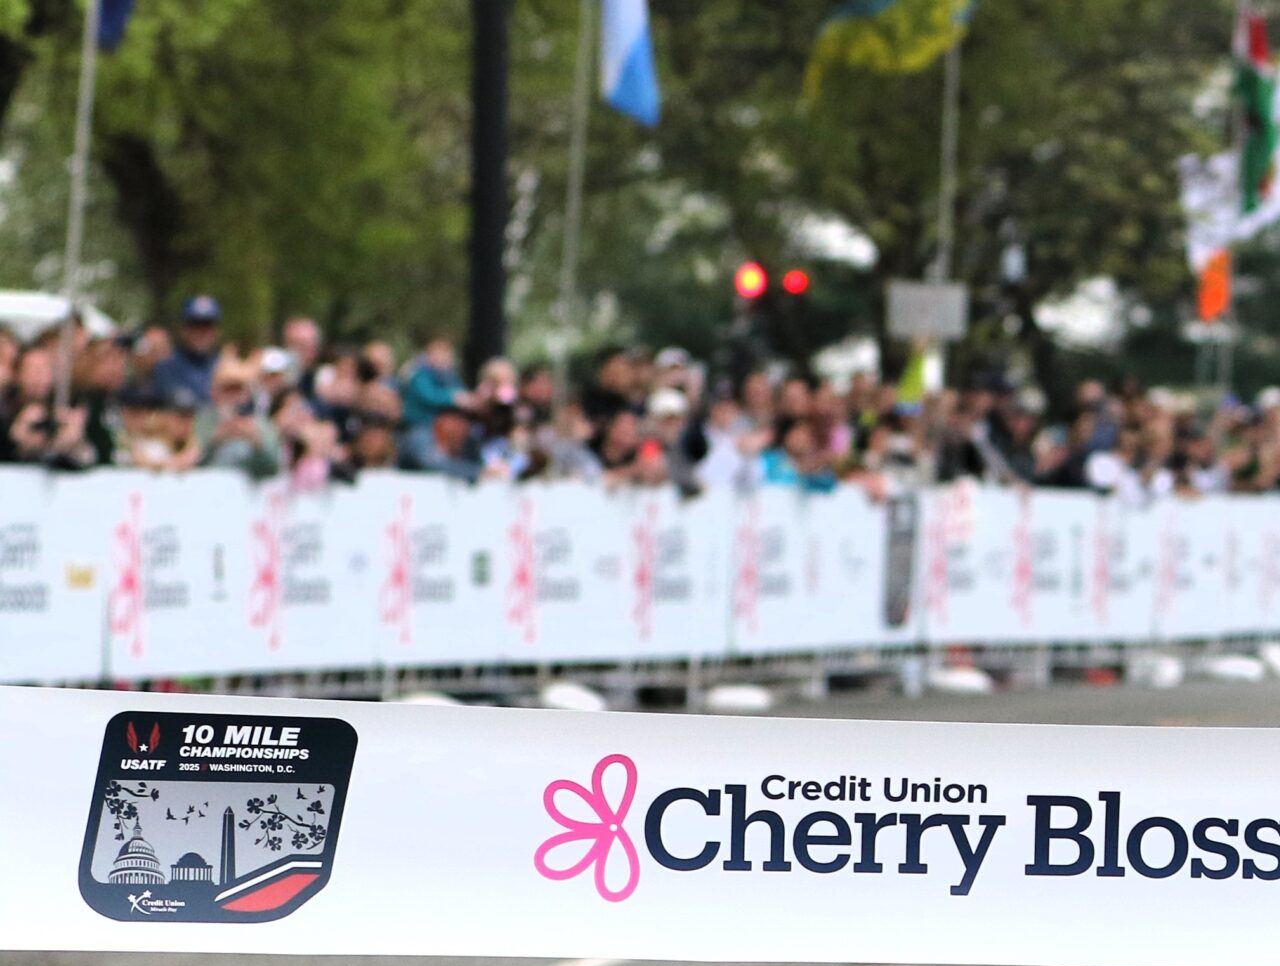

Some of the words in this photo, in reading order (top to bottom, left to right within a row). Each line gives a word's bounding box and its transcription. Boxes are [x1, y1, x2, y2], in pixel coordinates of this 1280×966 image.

[181, 724, 214, 744] 10
[223, 725, 301, 747] MILE
[179, 745, 310, 760] CHAMPIONSHIPS
[120, 758, 167, 771] USATF
[178, 762, 200, 772] 2025
[208, 763, 275, 774] WASHINGTON,
[276, 764, 296, 774] D.C.
[760, 774, 872, 802] Credit
[883, 777, 988, 804] Union
[644, 786, 1007, 896] Cherry
[142, 899, 164, 907] Credit
[164, 899, 186, 907] Union
